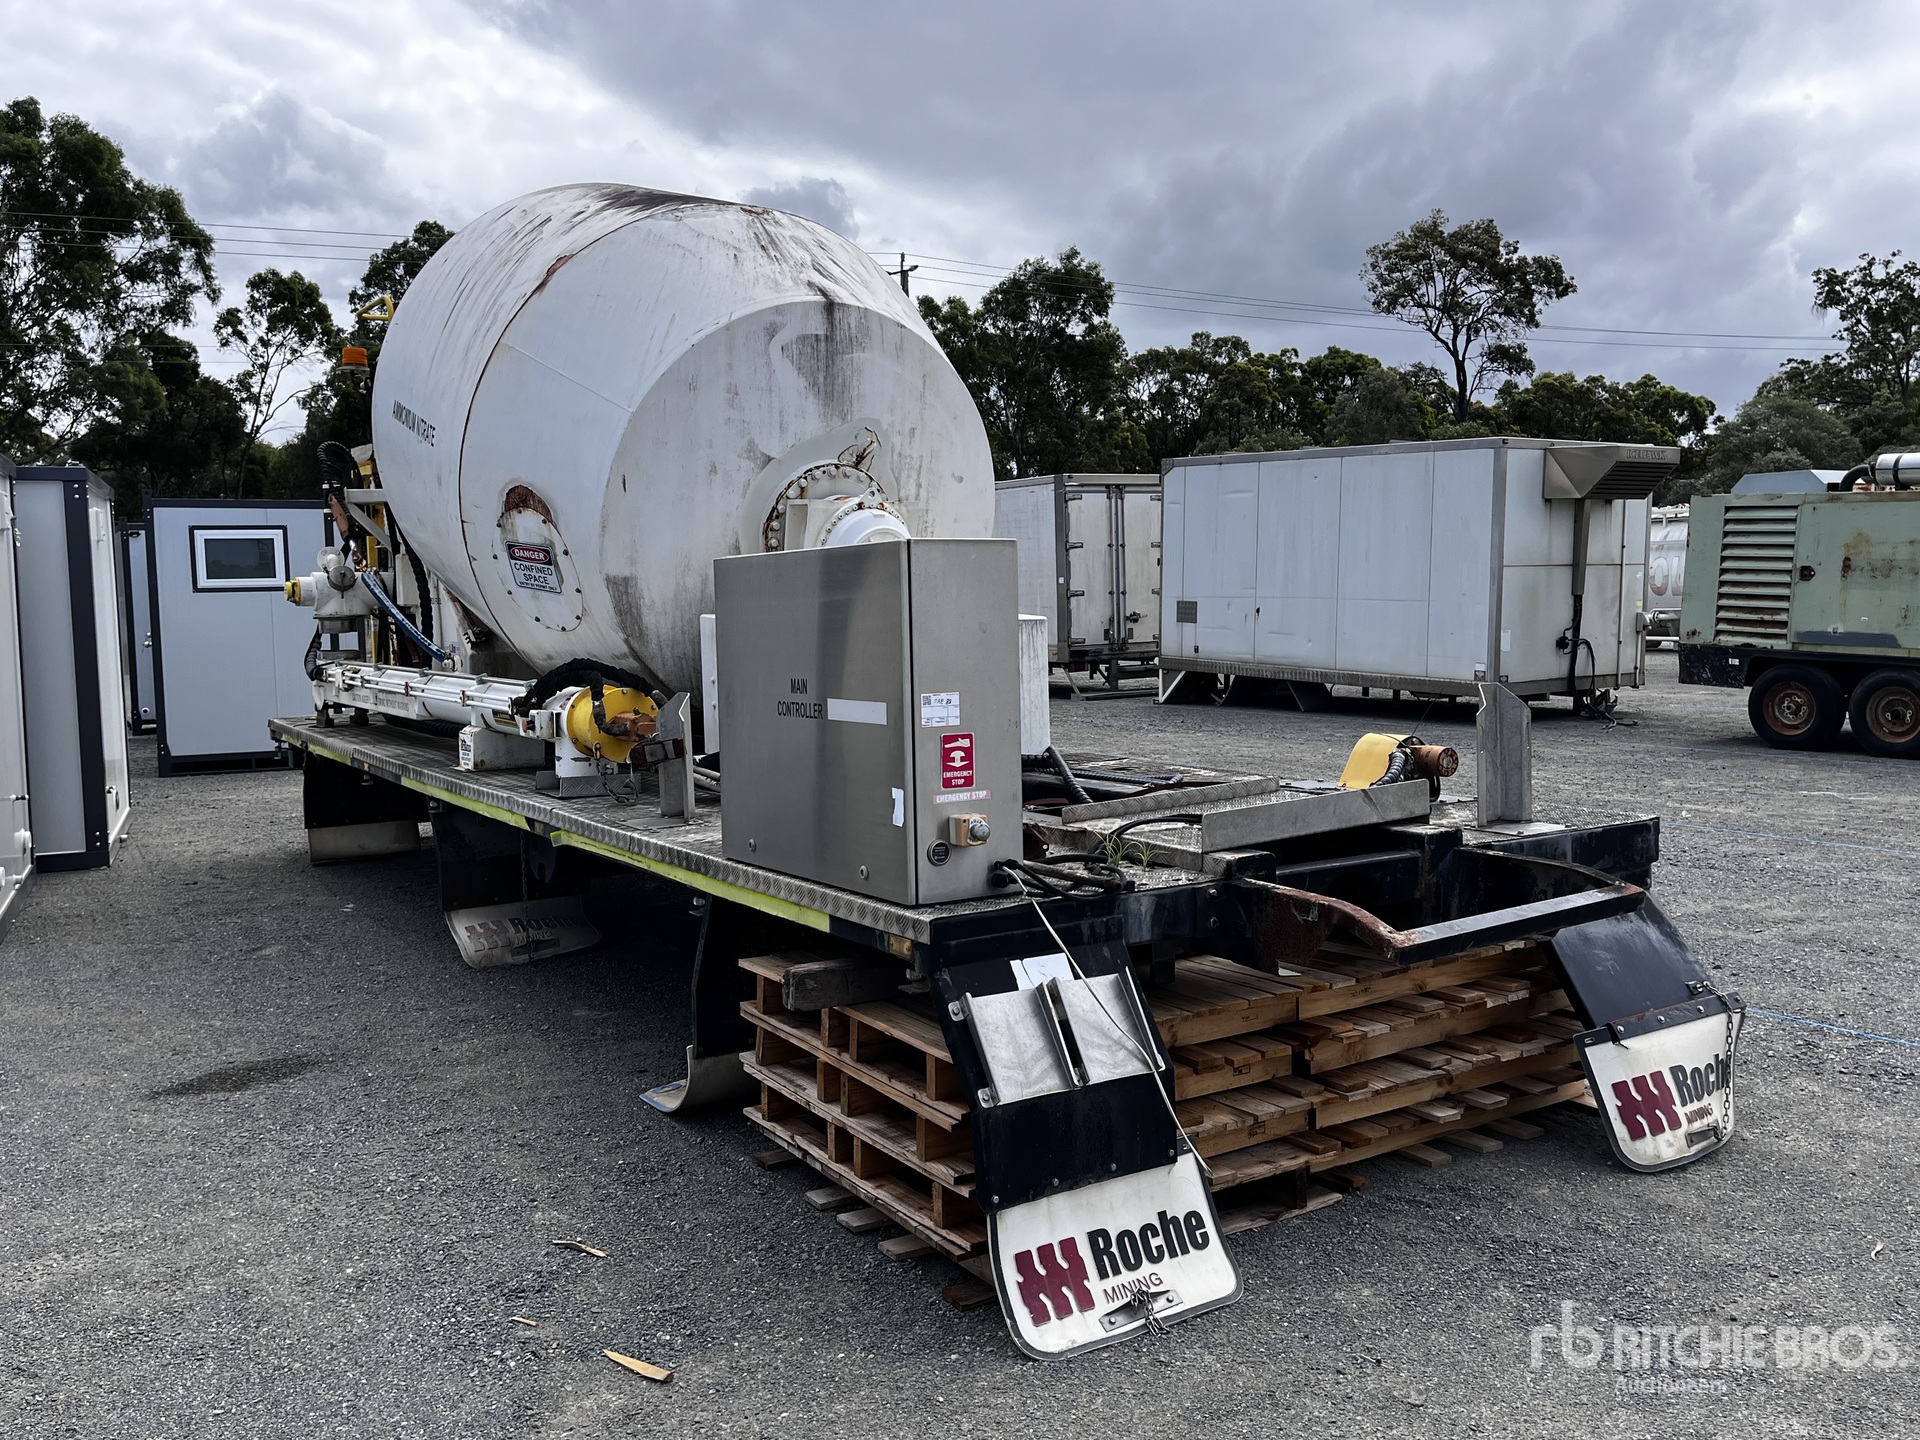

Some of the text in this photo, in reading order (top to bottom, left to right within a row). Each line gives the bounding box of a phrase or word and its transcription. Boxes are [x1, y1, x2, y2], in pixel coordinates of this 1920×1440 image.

[514, 549, 546, 560] DANGER
[514, 563, 553, 576] CONFINED
[523, 573, 550, 585] SPACE
[790, 678, 808, 695] MAIN
[777, 701, 823, 719] CONTROLLER
[943, 770, 973, 778] EMERGENCY
[936, 790, 987, 803] EMERGENCY STOP
[1669, 1053, 1732, 1107] Roch
[1684, 1103, 1714, 1126] MINING
[1086, 1209, 1210, 1281] Roche
[1103, 1272, 1164, 1304] MINING
